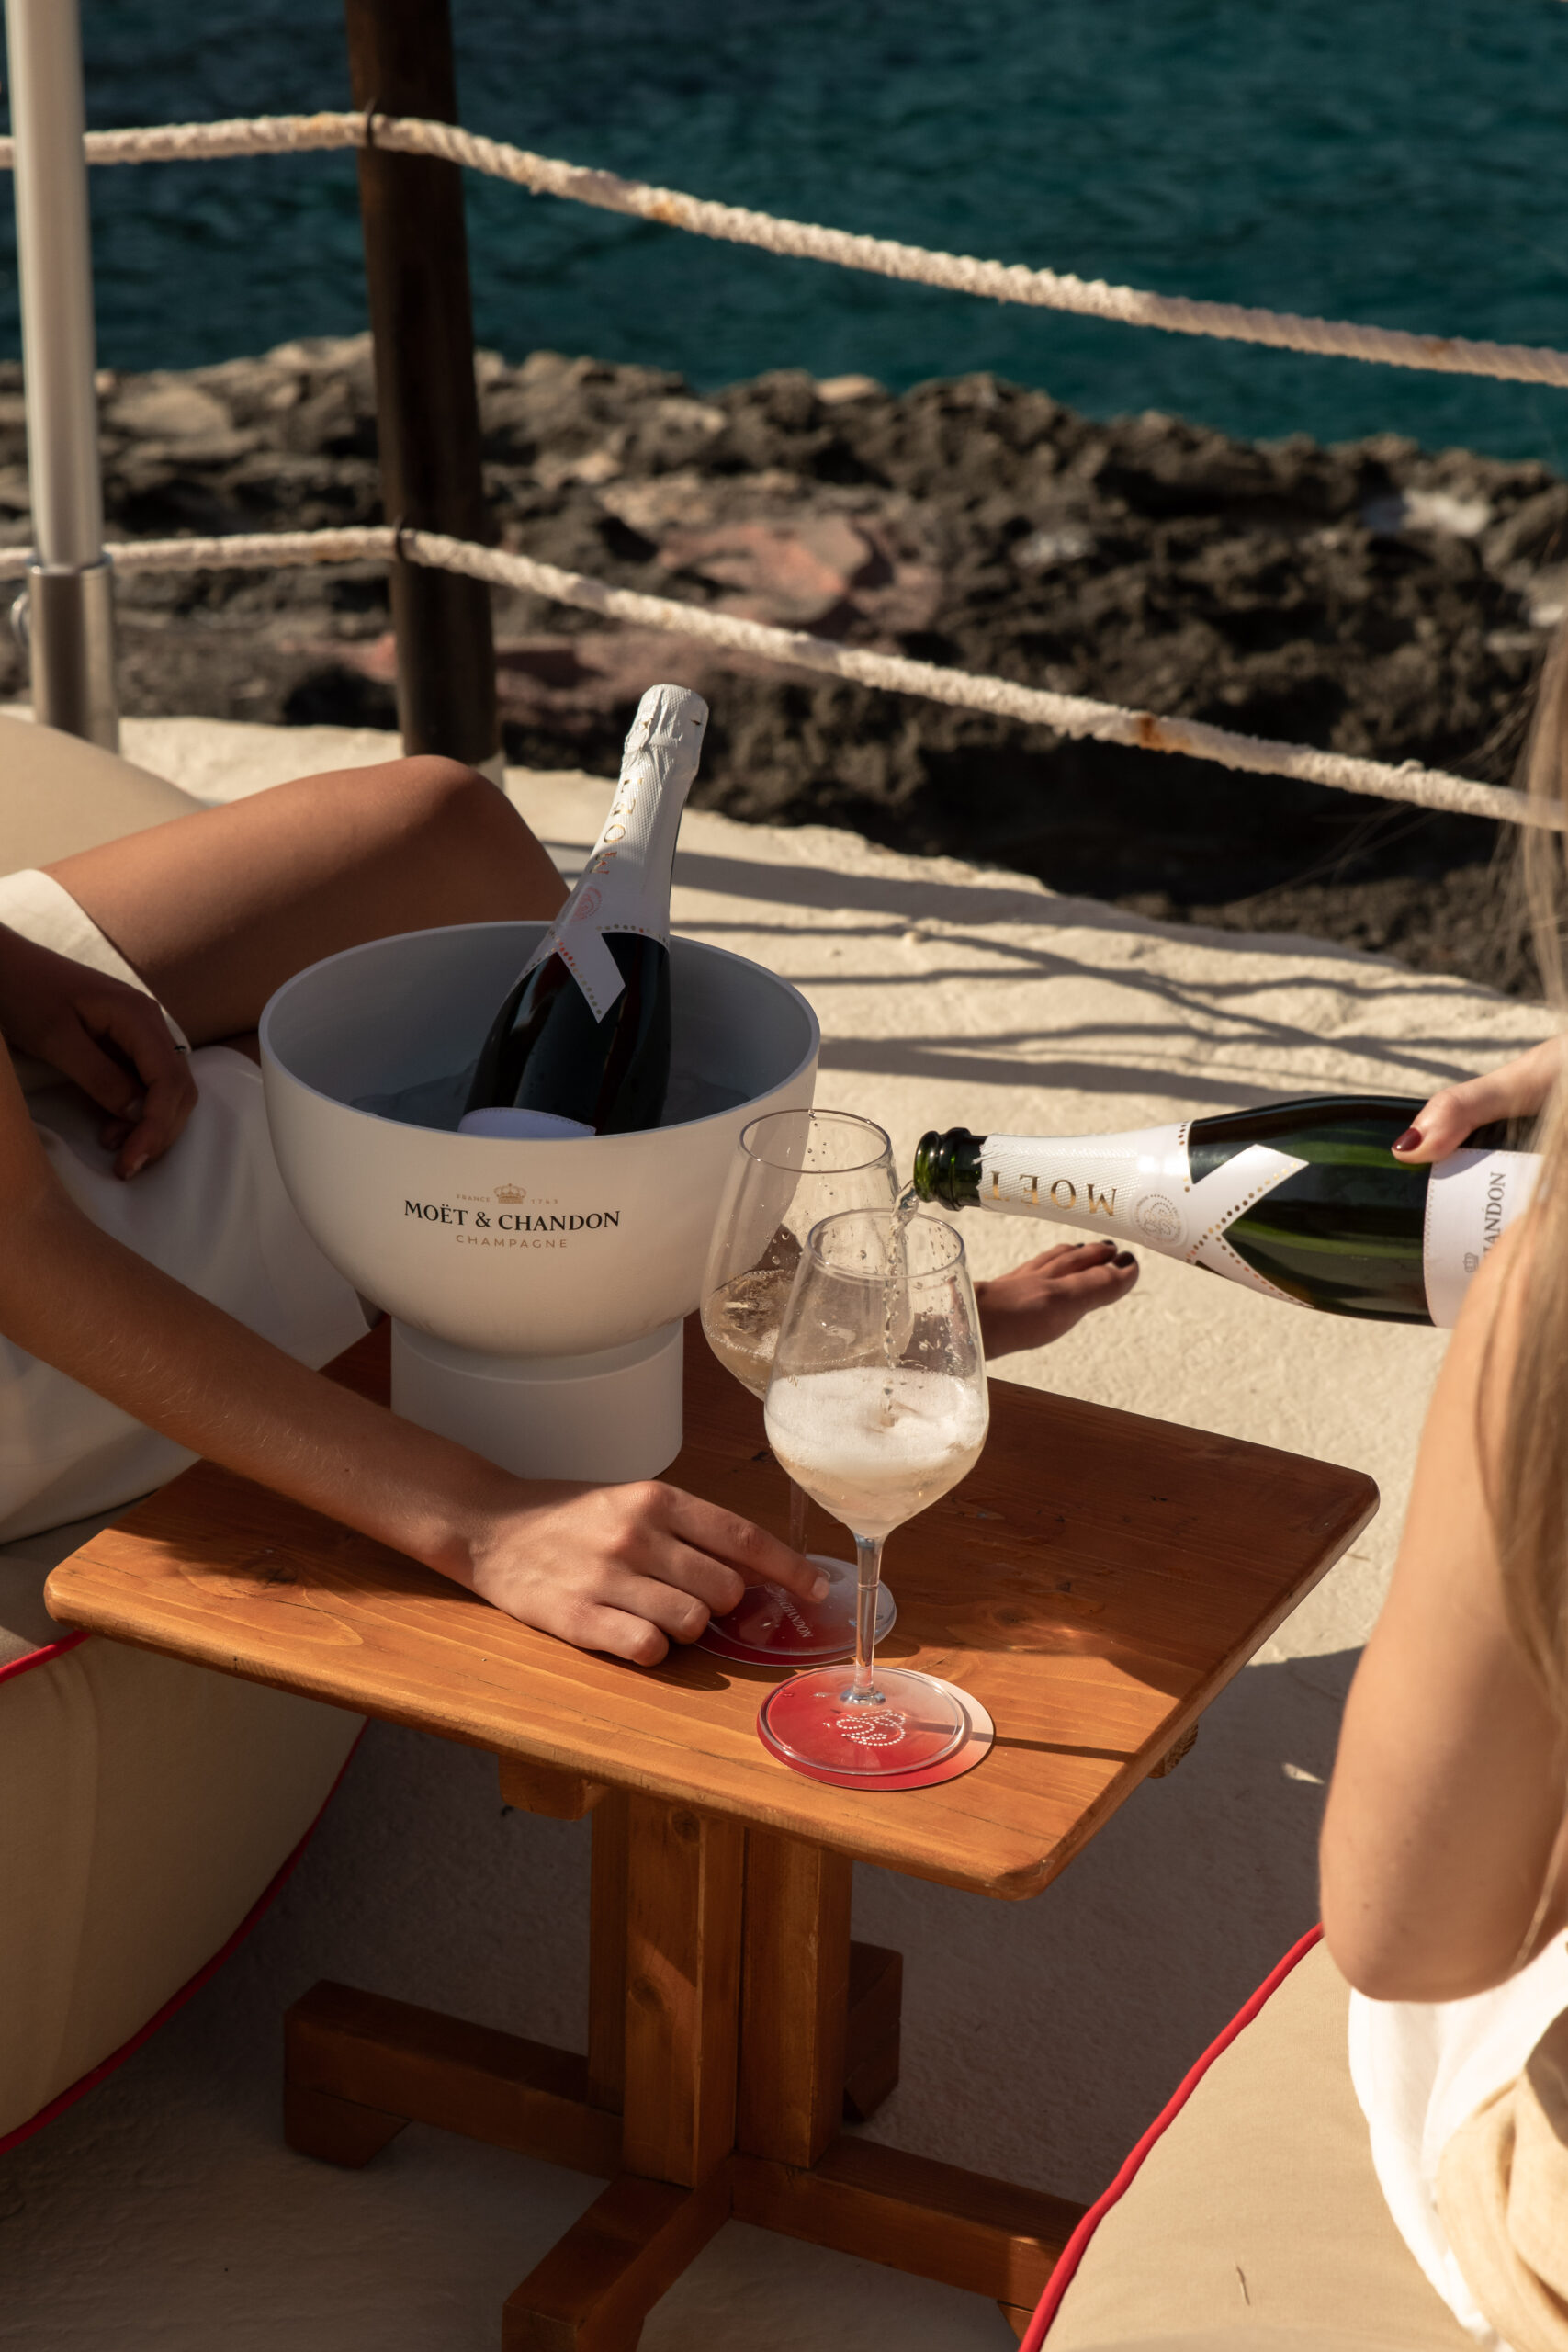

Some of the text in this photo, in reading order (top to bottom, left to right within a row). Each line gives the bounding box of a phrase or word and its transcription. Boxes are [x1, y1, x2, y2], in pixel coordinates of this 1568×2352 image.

[457, 1193, 491, 1203] FRANCE
[1483, 1171, 1506, 1255] ANDON
[404, 1200, 621, 1232] MOËT & CHANDON
[456, 1234, 568, 1249] CHAMPAGNE
[780, 1600, 814, 1638] CHANDON
